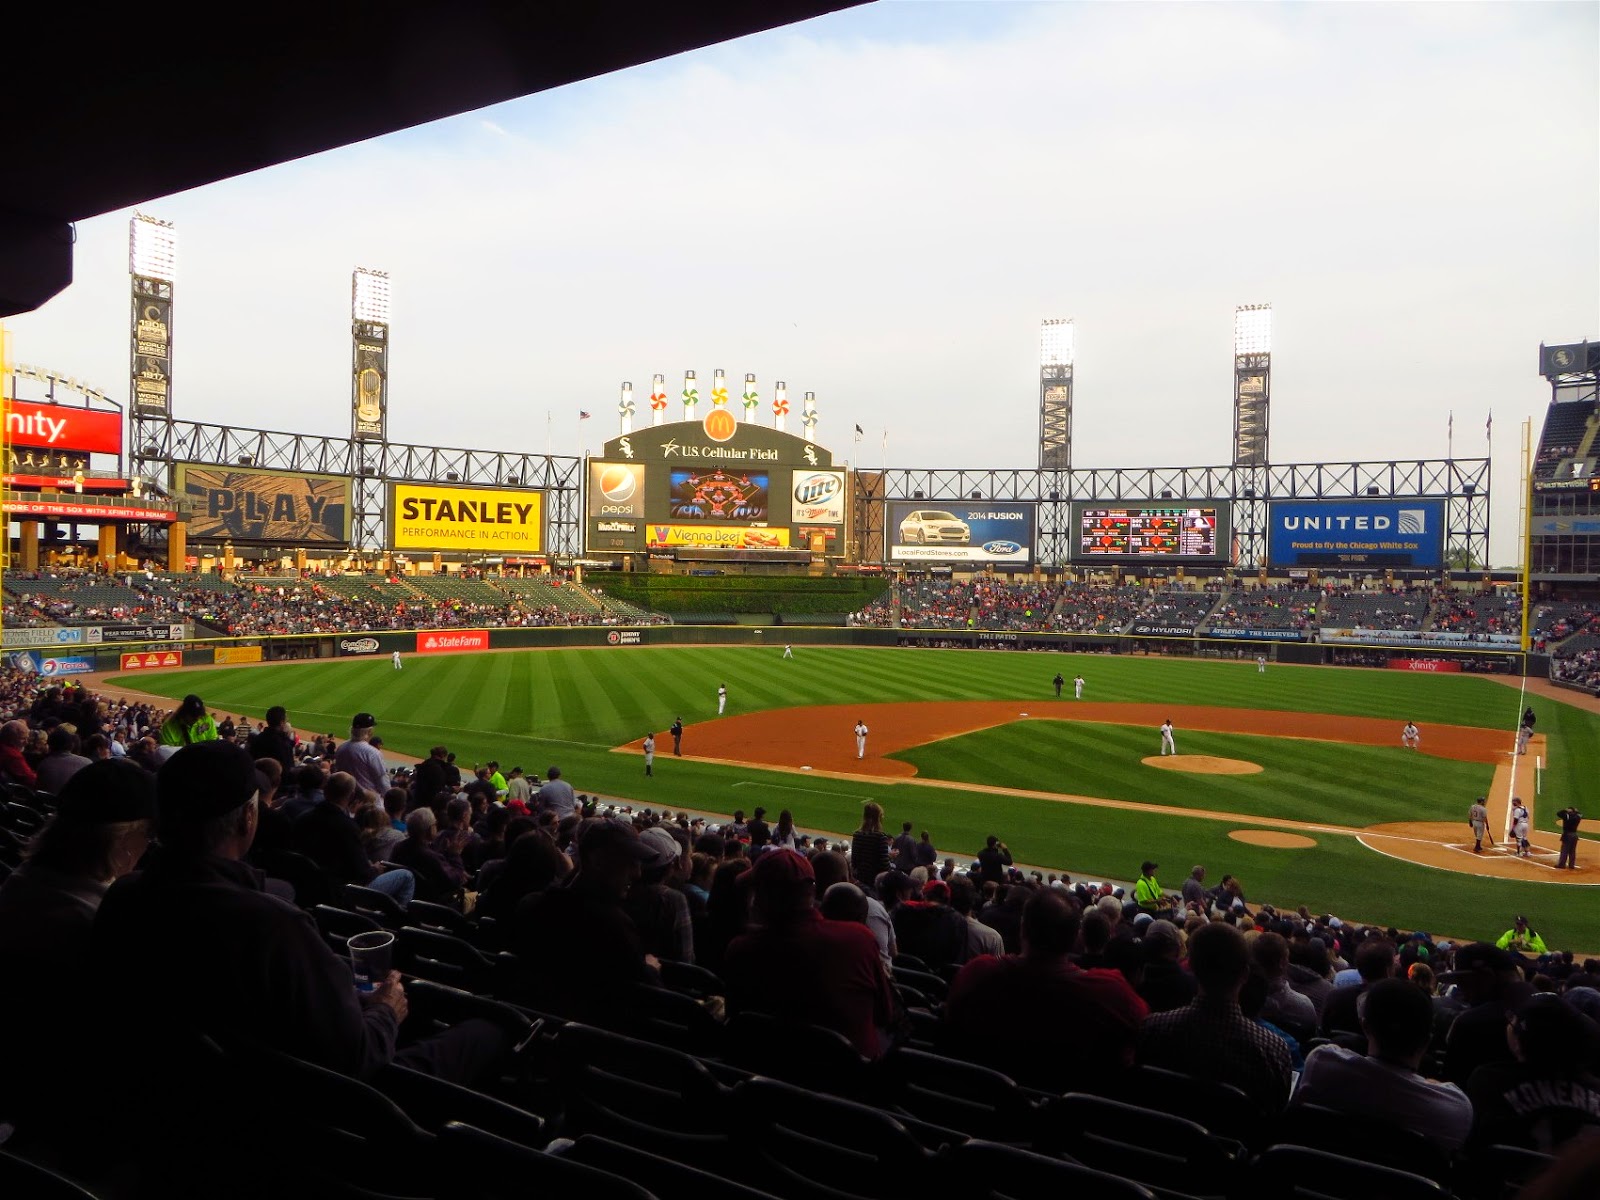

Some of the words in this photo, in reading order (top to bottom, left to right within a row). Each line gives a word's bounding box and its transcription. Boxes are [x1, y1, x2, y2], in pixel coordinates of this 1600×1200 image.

[138, 341, 166, 349] WORLD
[358, 344, 382, 353] 2005
[140, 372, 164, 380] 1917
[682, 446, 700, 458] U.S.
[702, 446, 747, 459] Cellular
[750, 448, 778, 460] Field
[802, 480, 836, 504] Lite
[208, 489, 327, 524] PLAY
[402, 497, 534, 524] STANLEY
[602, 505, 633, 514] pepsi
[108, 509, 134, 517] XFINITY
[968, 512, 986, 520] 2014
[988, 512, 1024, 520] FUSION
[1284, 516, 1390, 530] UNITED
[402, 528, 476, 538] PERFORMANCE
[478, 529, 490, 538] IN
[492, 530, 530, 540] ACTION
[674, 528, 712, 542] Vienna
[716, 529, 740, 544] Beef
[986, 542, 1014, 554] Ford
[1324, 542, 1334, 550] fly
[1350, 542, 1378, 550] Chicago
[897, 548, 968, 558] LocalFordStores.com
[1408, 662, 1438, 671] xfinity
